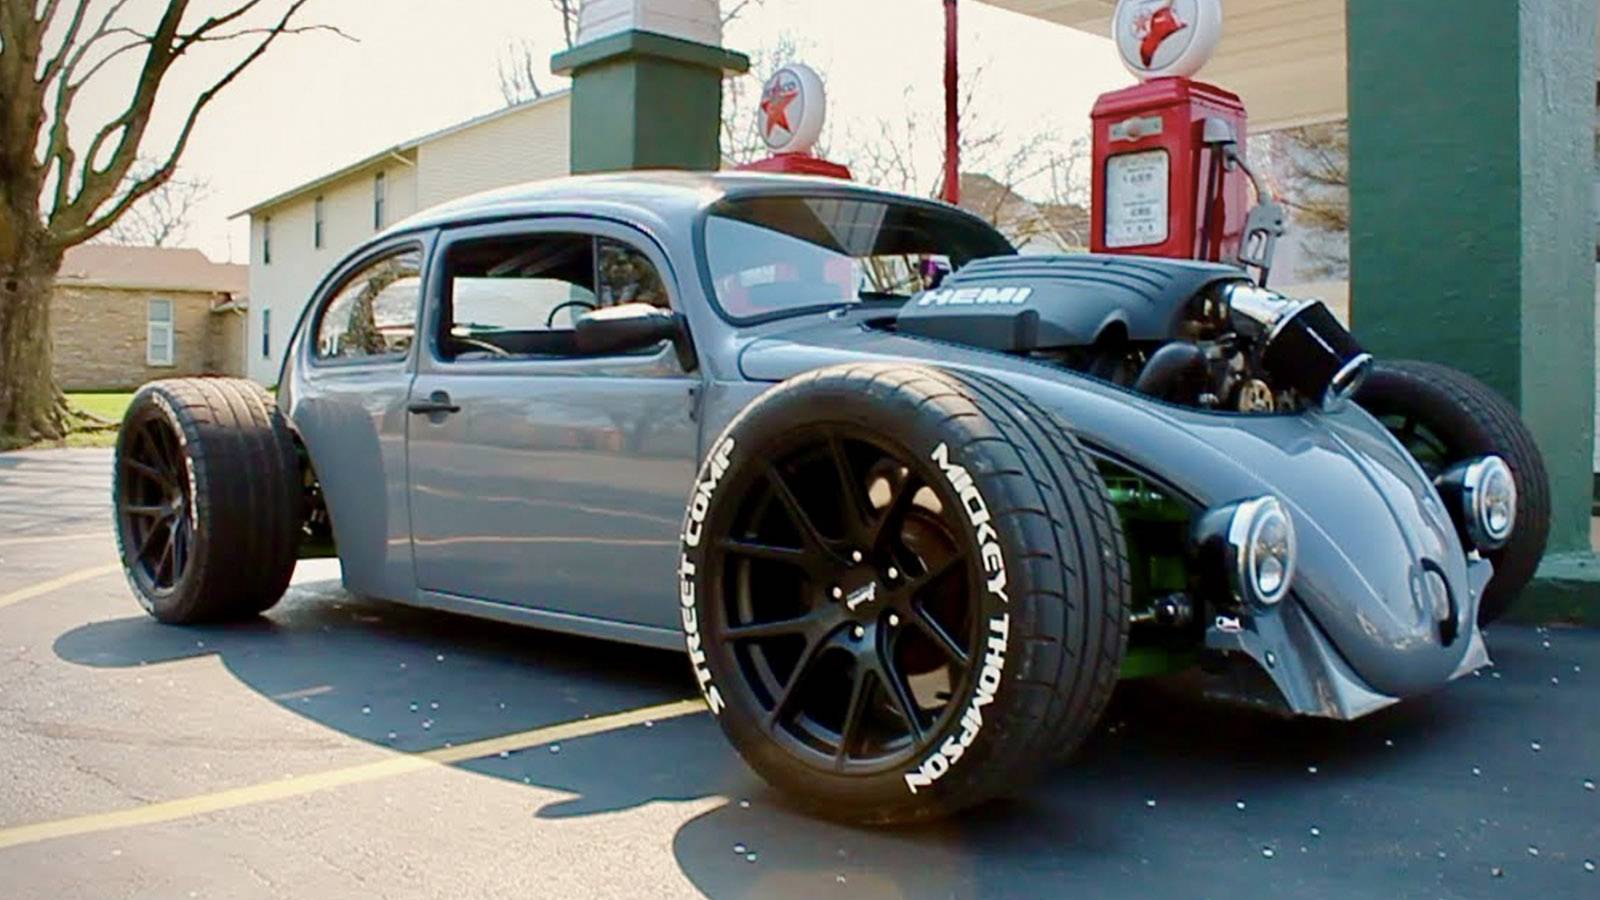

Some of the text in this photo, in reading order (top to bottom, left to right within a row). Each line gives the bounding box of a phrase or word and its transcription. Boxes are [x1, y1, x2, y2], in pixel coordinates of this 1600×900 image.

[918, 287, 1032, 305] HEMI
[679, 437, 736, 715] STREET COMP
[904, 443, 1011, 794] MICKEY THOMPSON
